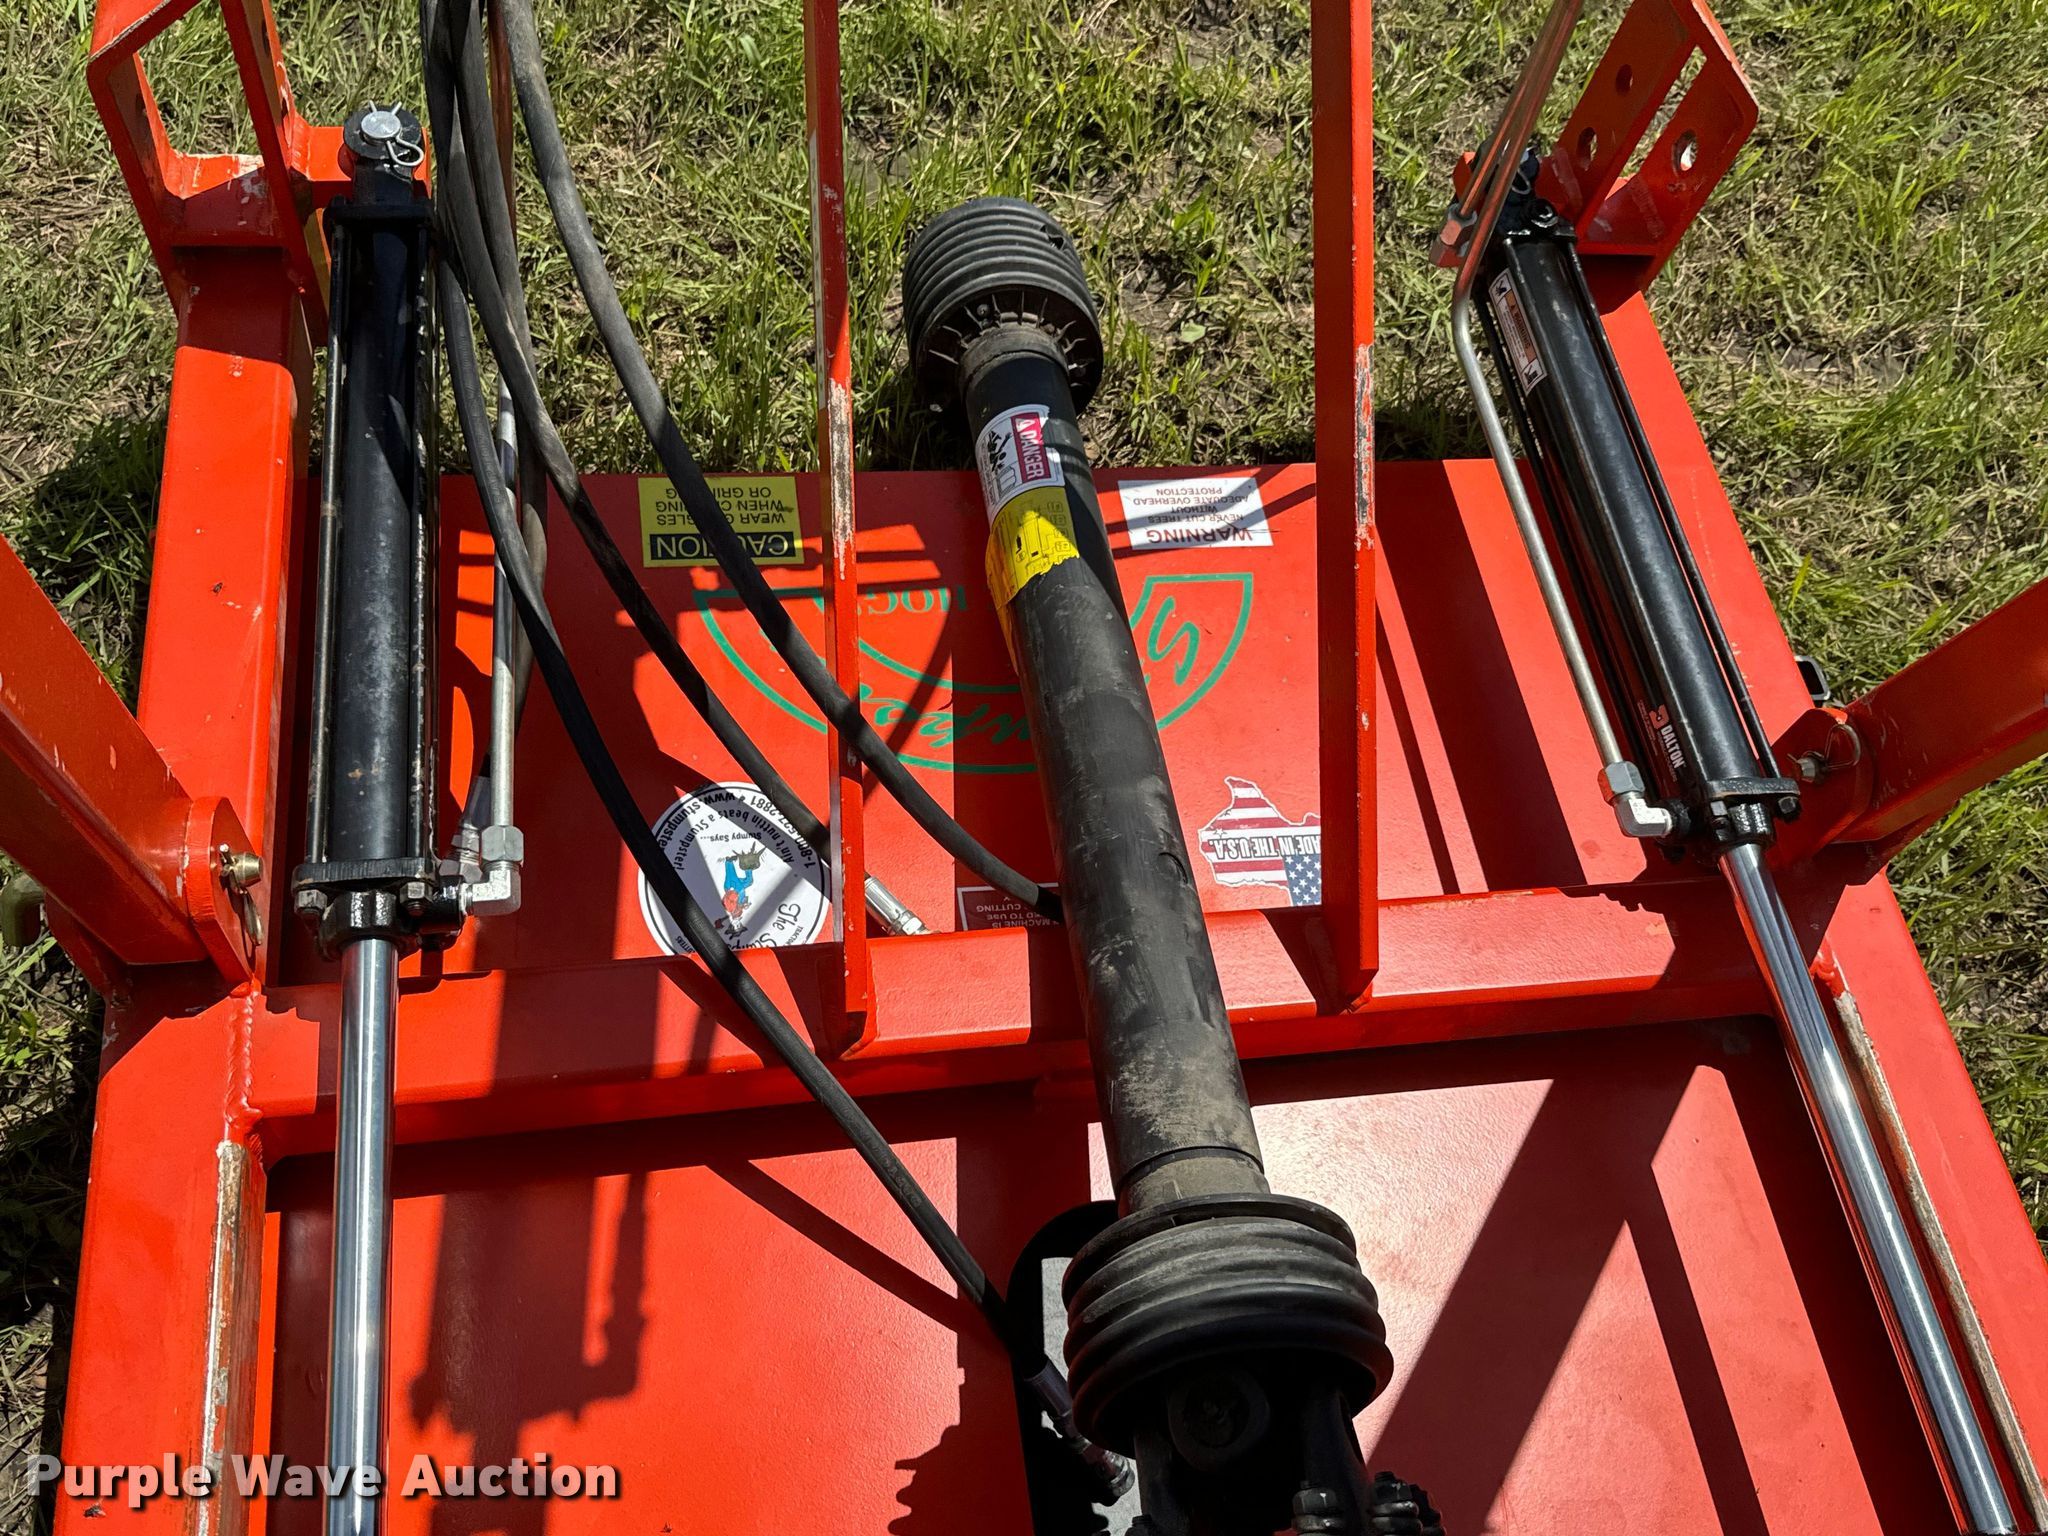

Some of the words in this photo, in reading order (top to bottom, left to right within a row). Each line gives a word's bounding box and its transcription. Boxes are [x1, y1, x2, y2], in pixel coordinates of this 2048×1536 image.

[1021, 431, 1045, 481] DANGER
[749, 486, 772, 498] OR
[1156, 487, 1223, 496] PROTECTION
[738, 499, 784, 511] WHEN
[1133, 497, 1191, 506] OVERHEAD
[1195, 495, 1248, 505] ADEQUATE
[1171, 505, 1218, 514] WITHOUT
[656, 513, 735, 526] GGLES
[740, 512, 785, 525] WEAR
[1147, 515, 1181, 524] TREES
[1186, 514, 1207, 523] CUT
[1209, 513, 1244, 522] NEVER
[1146, 527, 1253, 544] WARNING
[656, 534, 789, 558] CAION
[1660, 725, 1685, 769] DALTON
[708, 814, 717, 822] a
[718, 809, 750, 820] beats
[752, 815, 781, 842] nuttin
[731, 831, 762, 841] Stumpy
[1208, 838, 1251, 859] U.S.A.
[1251, 837, 1278, 857] THE
[1278, 836, 1295, 855] IN
[1295, 835, 1321, 855] ADE
[775, 842, 795, 863] Ain't
[976, 903, 1021, 913] CUTTING
[774, 903, 802, 931] The
[987, 913, 1007, 921] USE
[1004, 918, 1050, 928] MACHINE
